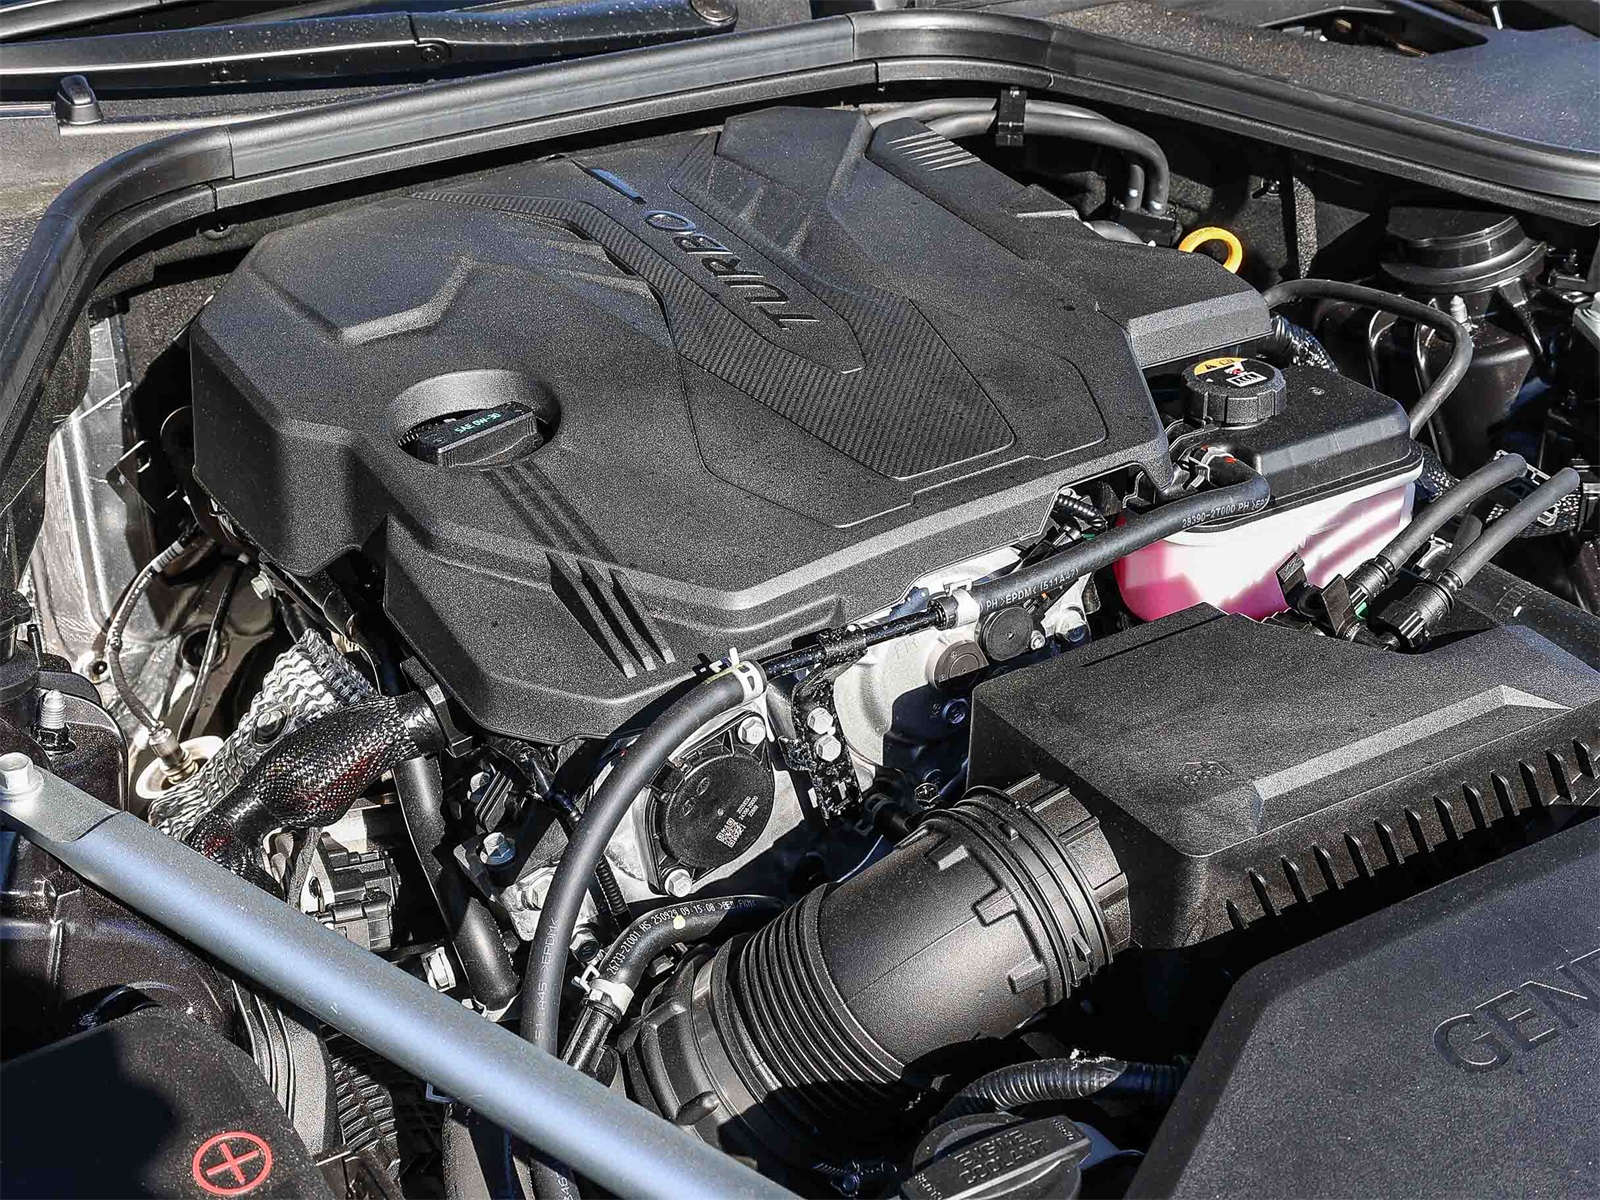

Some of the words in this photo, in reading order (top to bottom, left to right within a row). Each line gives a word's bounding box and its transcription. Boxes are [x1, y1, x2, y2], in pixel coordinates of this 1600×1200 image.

[645, 210, 820, 331] TURBO
[454, 420, 475, 434] SAE
[473, 412, 501, 427] 0W-30
[1238, 500, 1250, 512] PH
[986, 599, 998, 612] PH
[641, 917, 652, 934] HS
